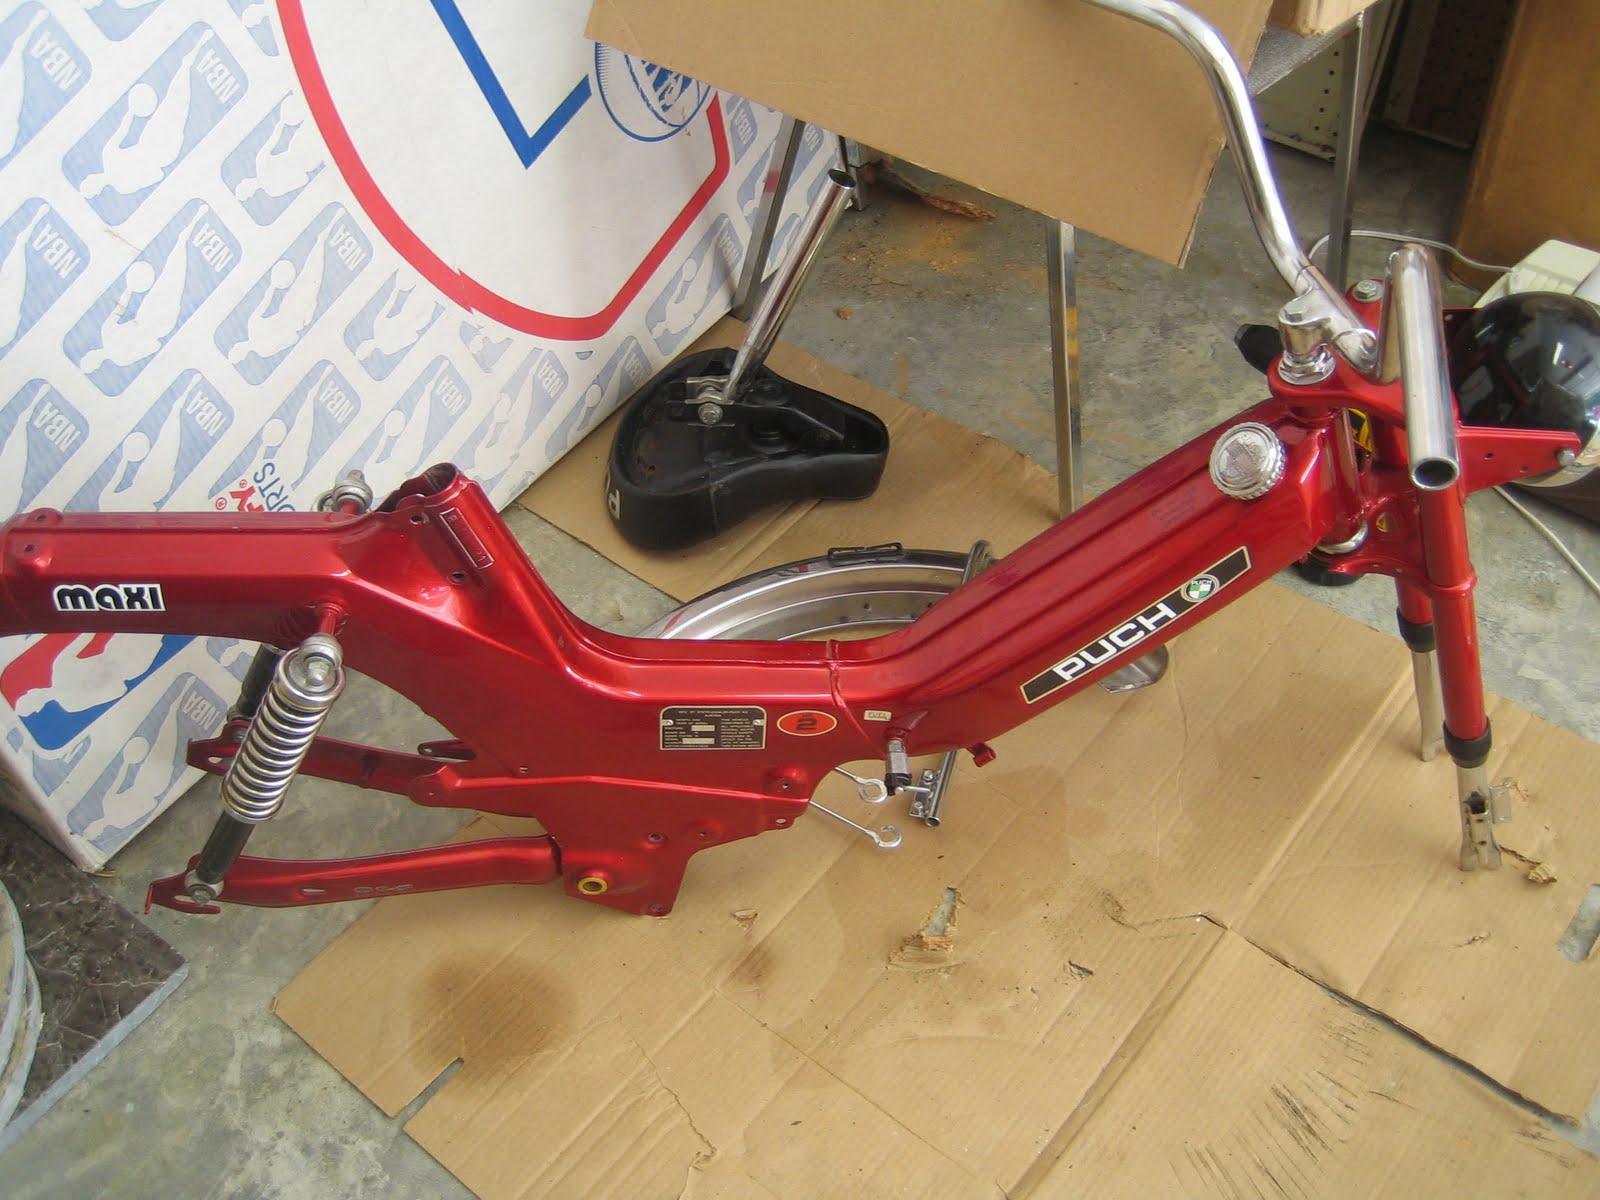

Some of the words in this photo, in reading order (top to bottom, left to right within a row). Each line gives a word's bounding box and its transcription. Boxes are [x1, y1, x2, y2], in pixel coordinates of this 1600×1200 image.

[29, 30, 83, 92] NBA
[194, 48, 242, 104] NBA
[32, 224, 82, 280] NBA
[192, 214, 234, 273] NBA
[328, 224, 366, 271] NBA
[319, 380, 353, 424] NBA
[435, 374, 467, 416] NBA
[537, 361, 565, 399] NBA
[32, 400, 82, 453] NBA
[184, 389, 227, 437] NBA
[1052, 603, 1177, 681] PUCH
[182, 690, 220, 731] NBA
[796, 717, 818, 731] 2
